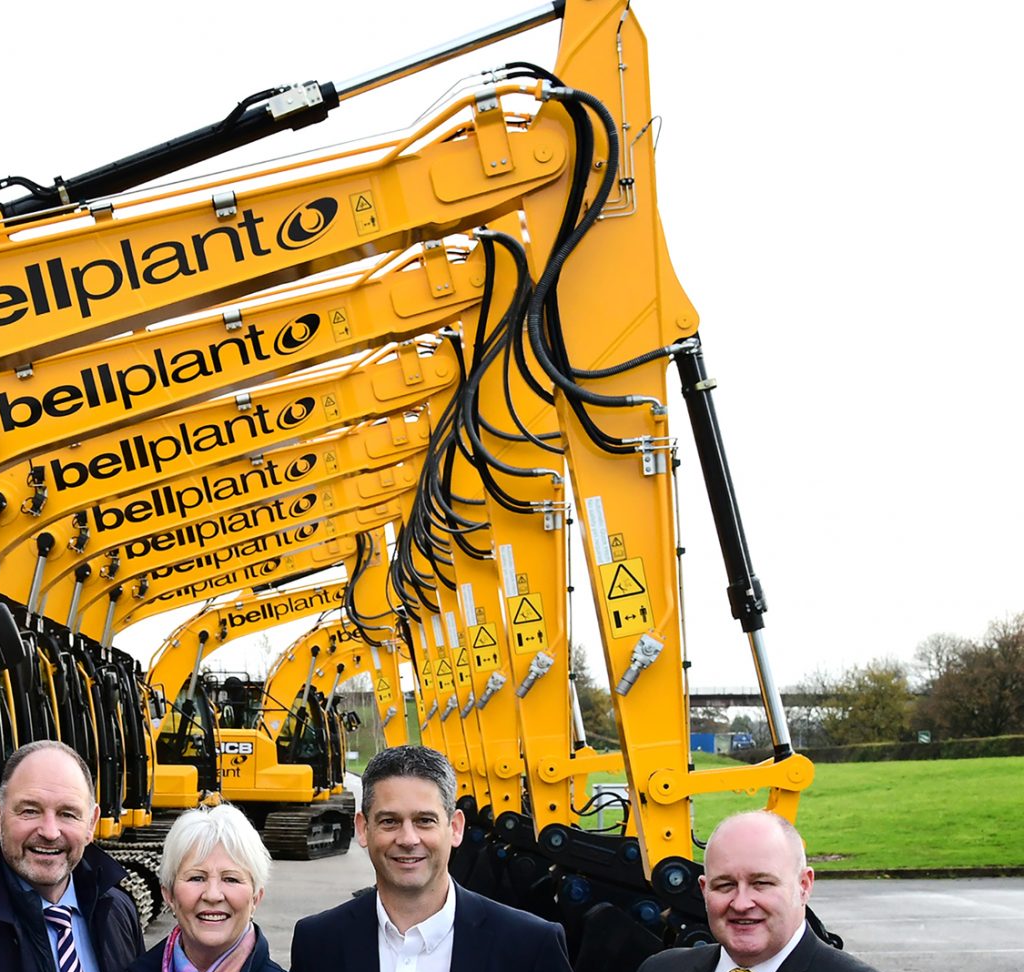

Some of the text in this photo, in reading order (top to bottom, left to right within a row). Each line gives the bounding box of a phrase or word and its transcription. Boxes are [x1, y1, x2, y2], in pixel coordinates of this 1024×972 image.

[51, 404, 274, 491] bellplant
[91, 460, 282, 533] bellplant
[125, 500, 287, 560] bellplant
[228, 589, 331, 629] bellplant
